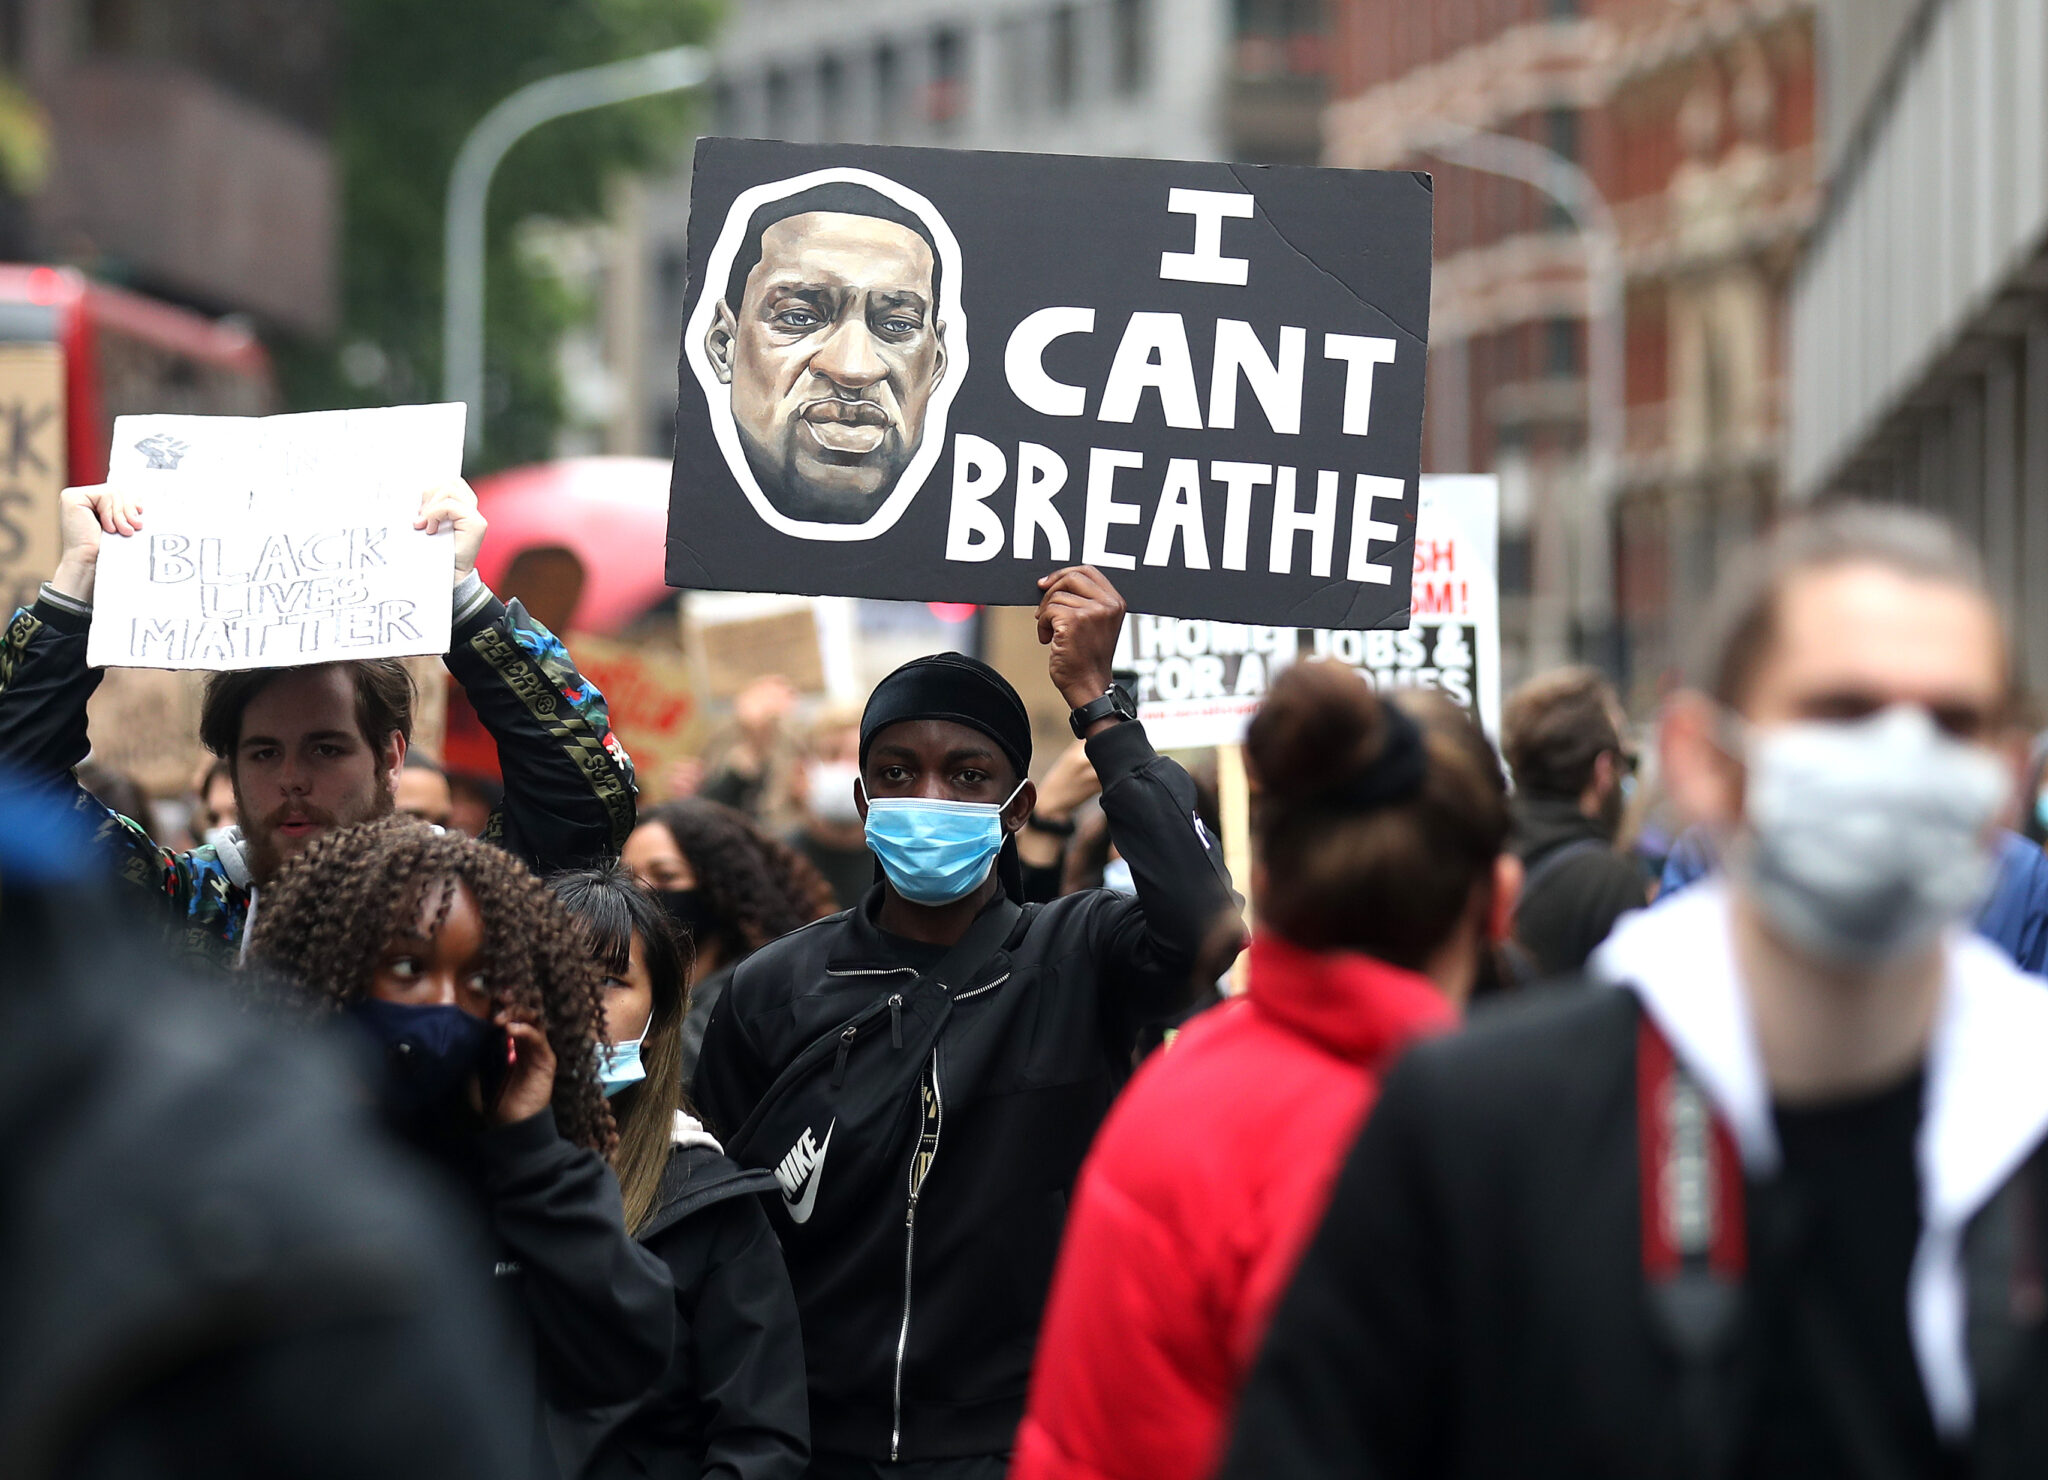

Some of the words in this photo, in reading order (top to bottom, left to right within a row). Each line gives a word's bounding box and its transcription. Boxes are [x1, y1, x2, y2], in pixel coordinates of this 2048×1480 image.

[1160, 187, 1254, 286] I
[1004, 306, 1397, 436] CANT
[945, 434, 1405, 585] BREATHE
[150, 527, 388, 584] BLACK
[200, 572, 369, 618] LIVES
[130, 600, 424, 661] MATTER
[1432, 620, 1473, 670] &
[774, 1126, 823, 1200] NIKE
